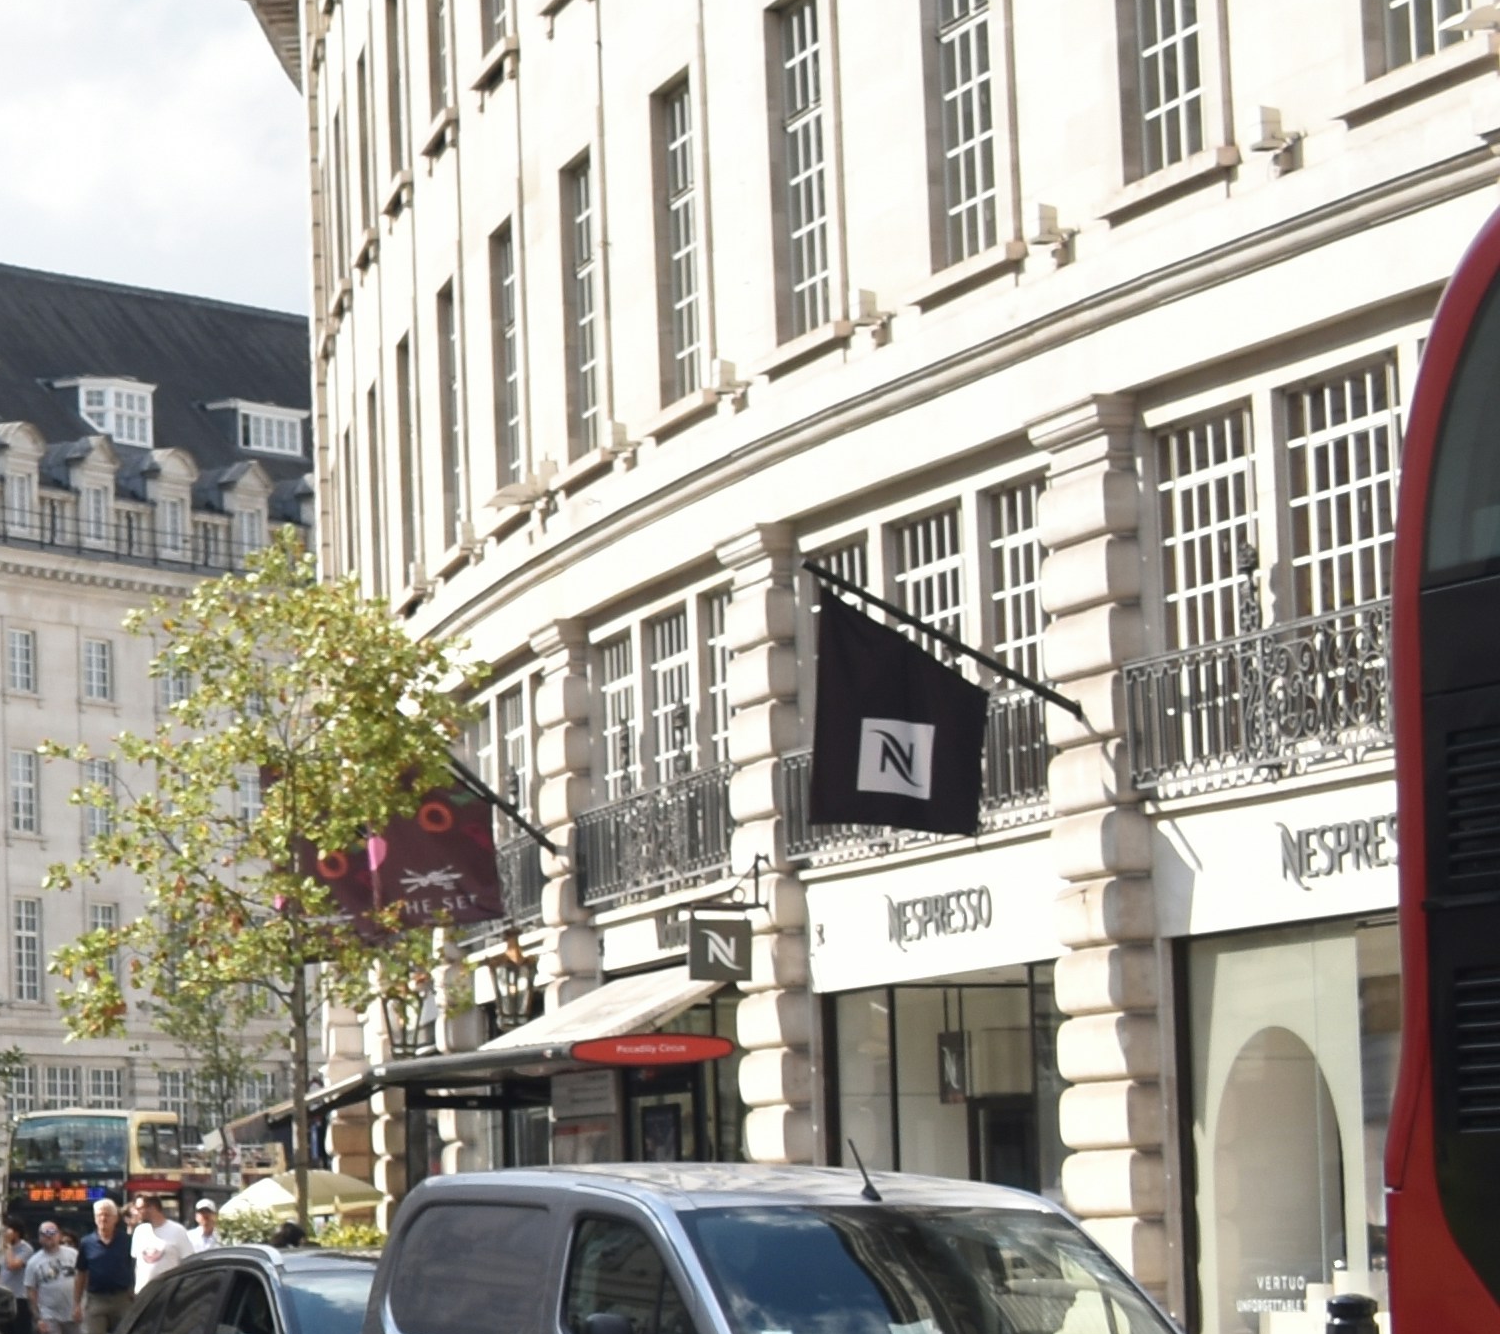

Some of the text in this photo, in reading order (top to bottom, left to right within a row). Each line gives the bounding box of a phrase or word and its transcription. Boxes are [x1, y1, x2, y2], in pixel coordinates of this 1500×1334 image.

[1274, 812, 1399, 892] NESPRES
[404, 899, 432, 915] HE
[884, 885, 992, 953] NESPRESSO
[616, 1043, 687, 1055] Piccadilly Circus
[1256, 1275, 1305, 1291] VERTUO
